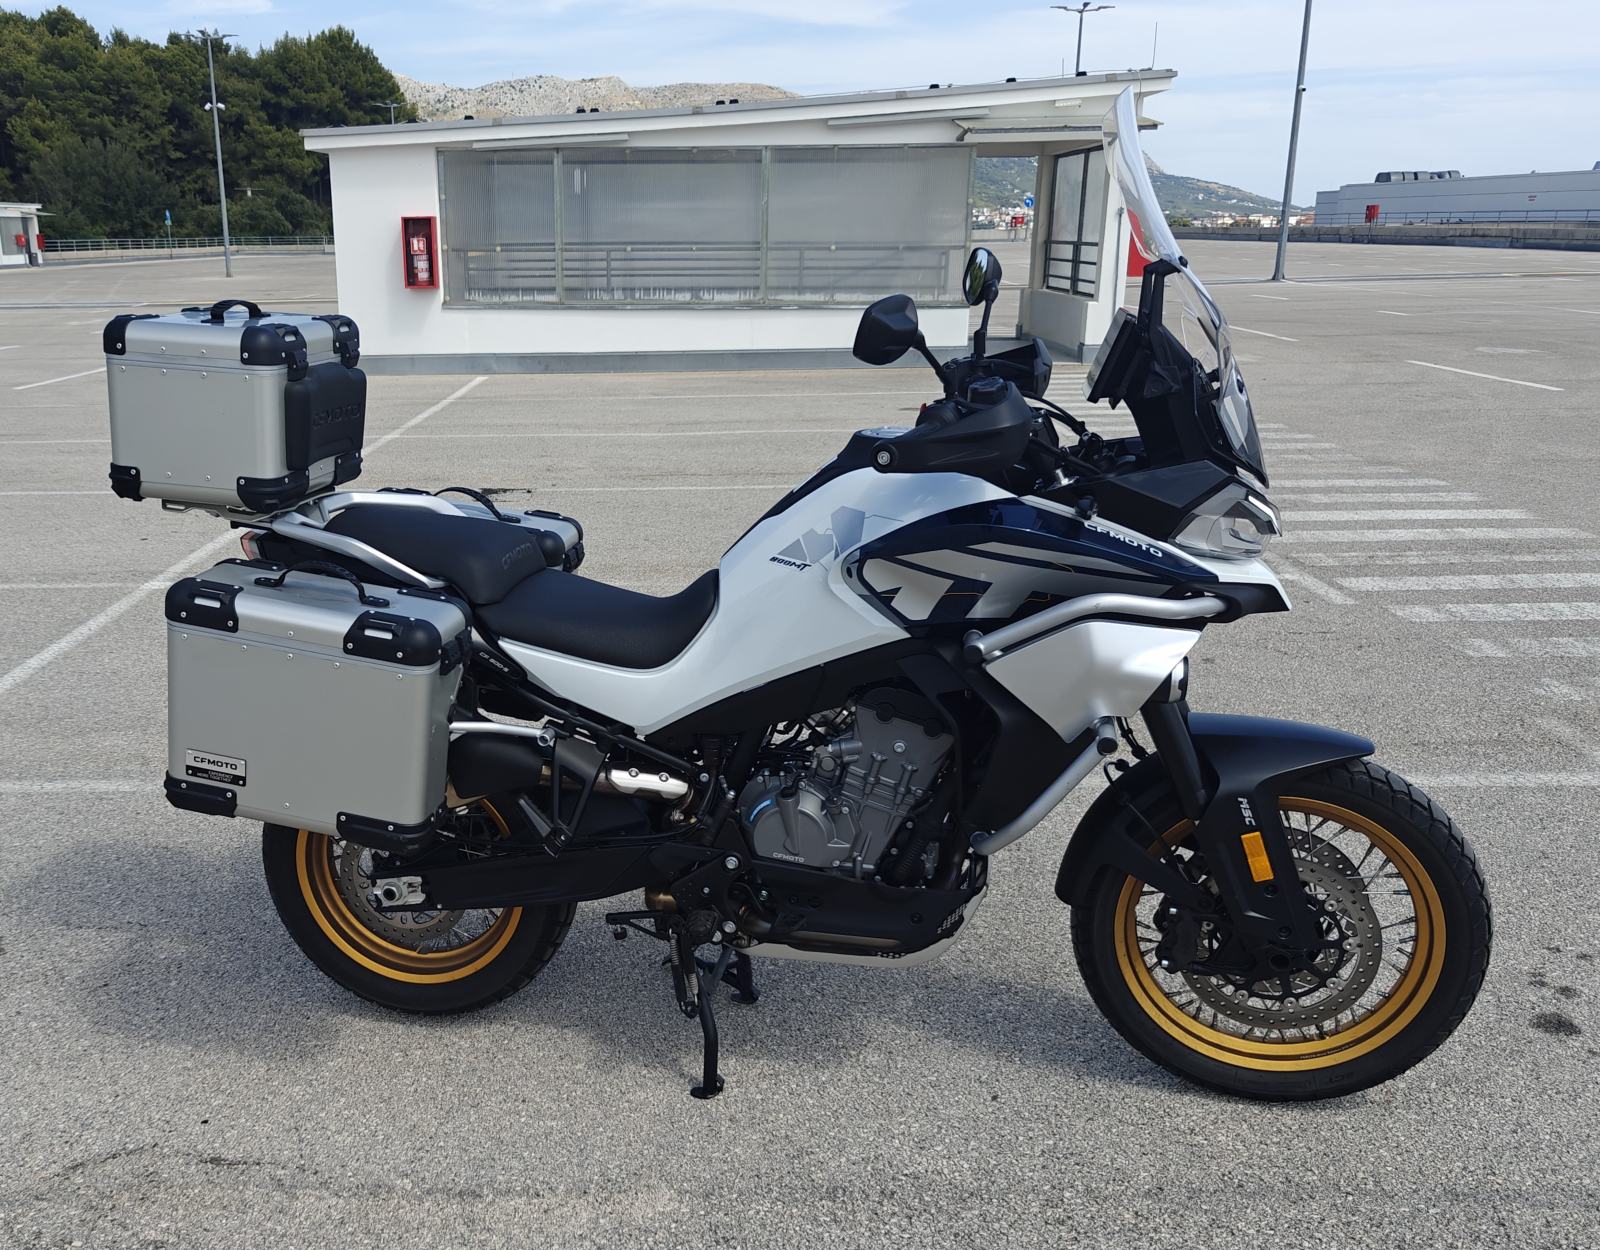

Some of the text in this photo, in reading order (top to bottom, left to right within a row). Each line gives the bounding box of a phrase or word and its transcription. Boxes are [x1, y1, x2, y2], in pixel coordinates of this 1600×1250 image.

[1083, 521, 1163, 558] CFMOTO
[769, 556, 812, 571] 800MT
[193, 756, 238, 771] CFMOTO
[1237, 797, 1256, 826] MSC
[772, 852, 805, 863] CFMOTO
